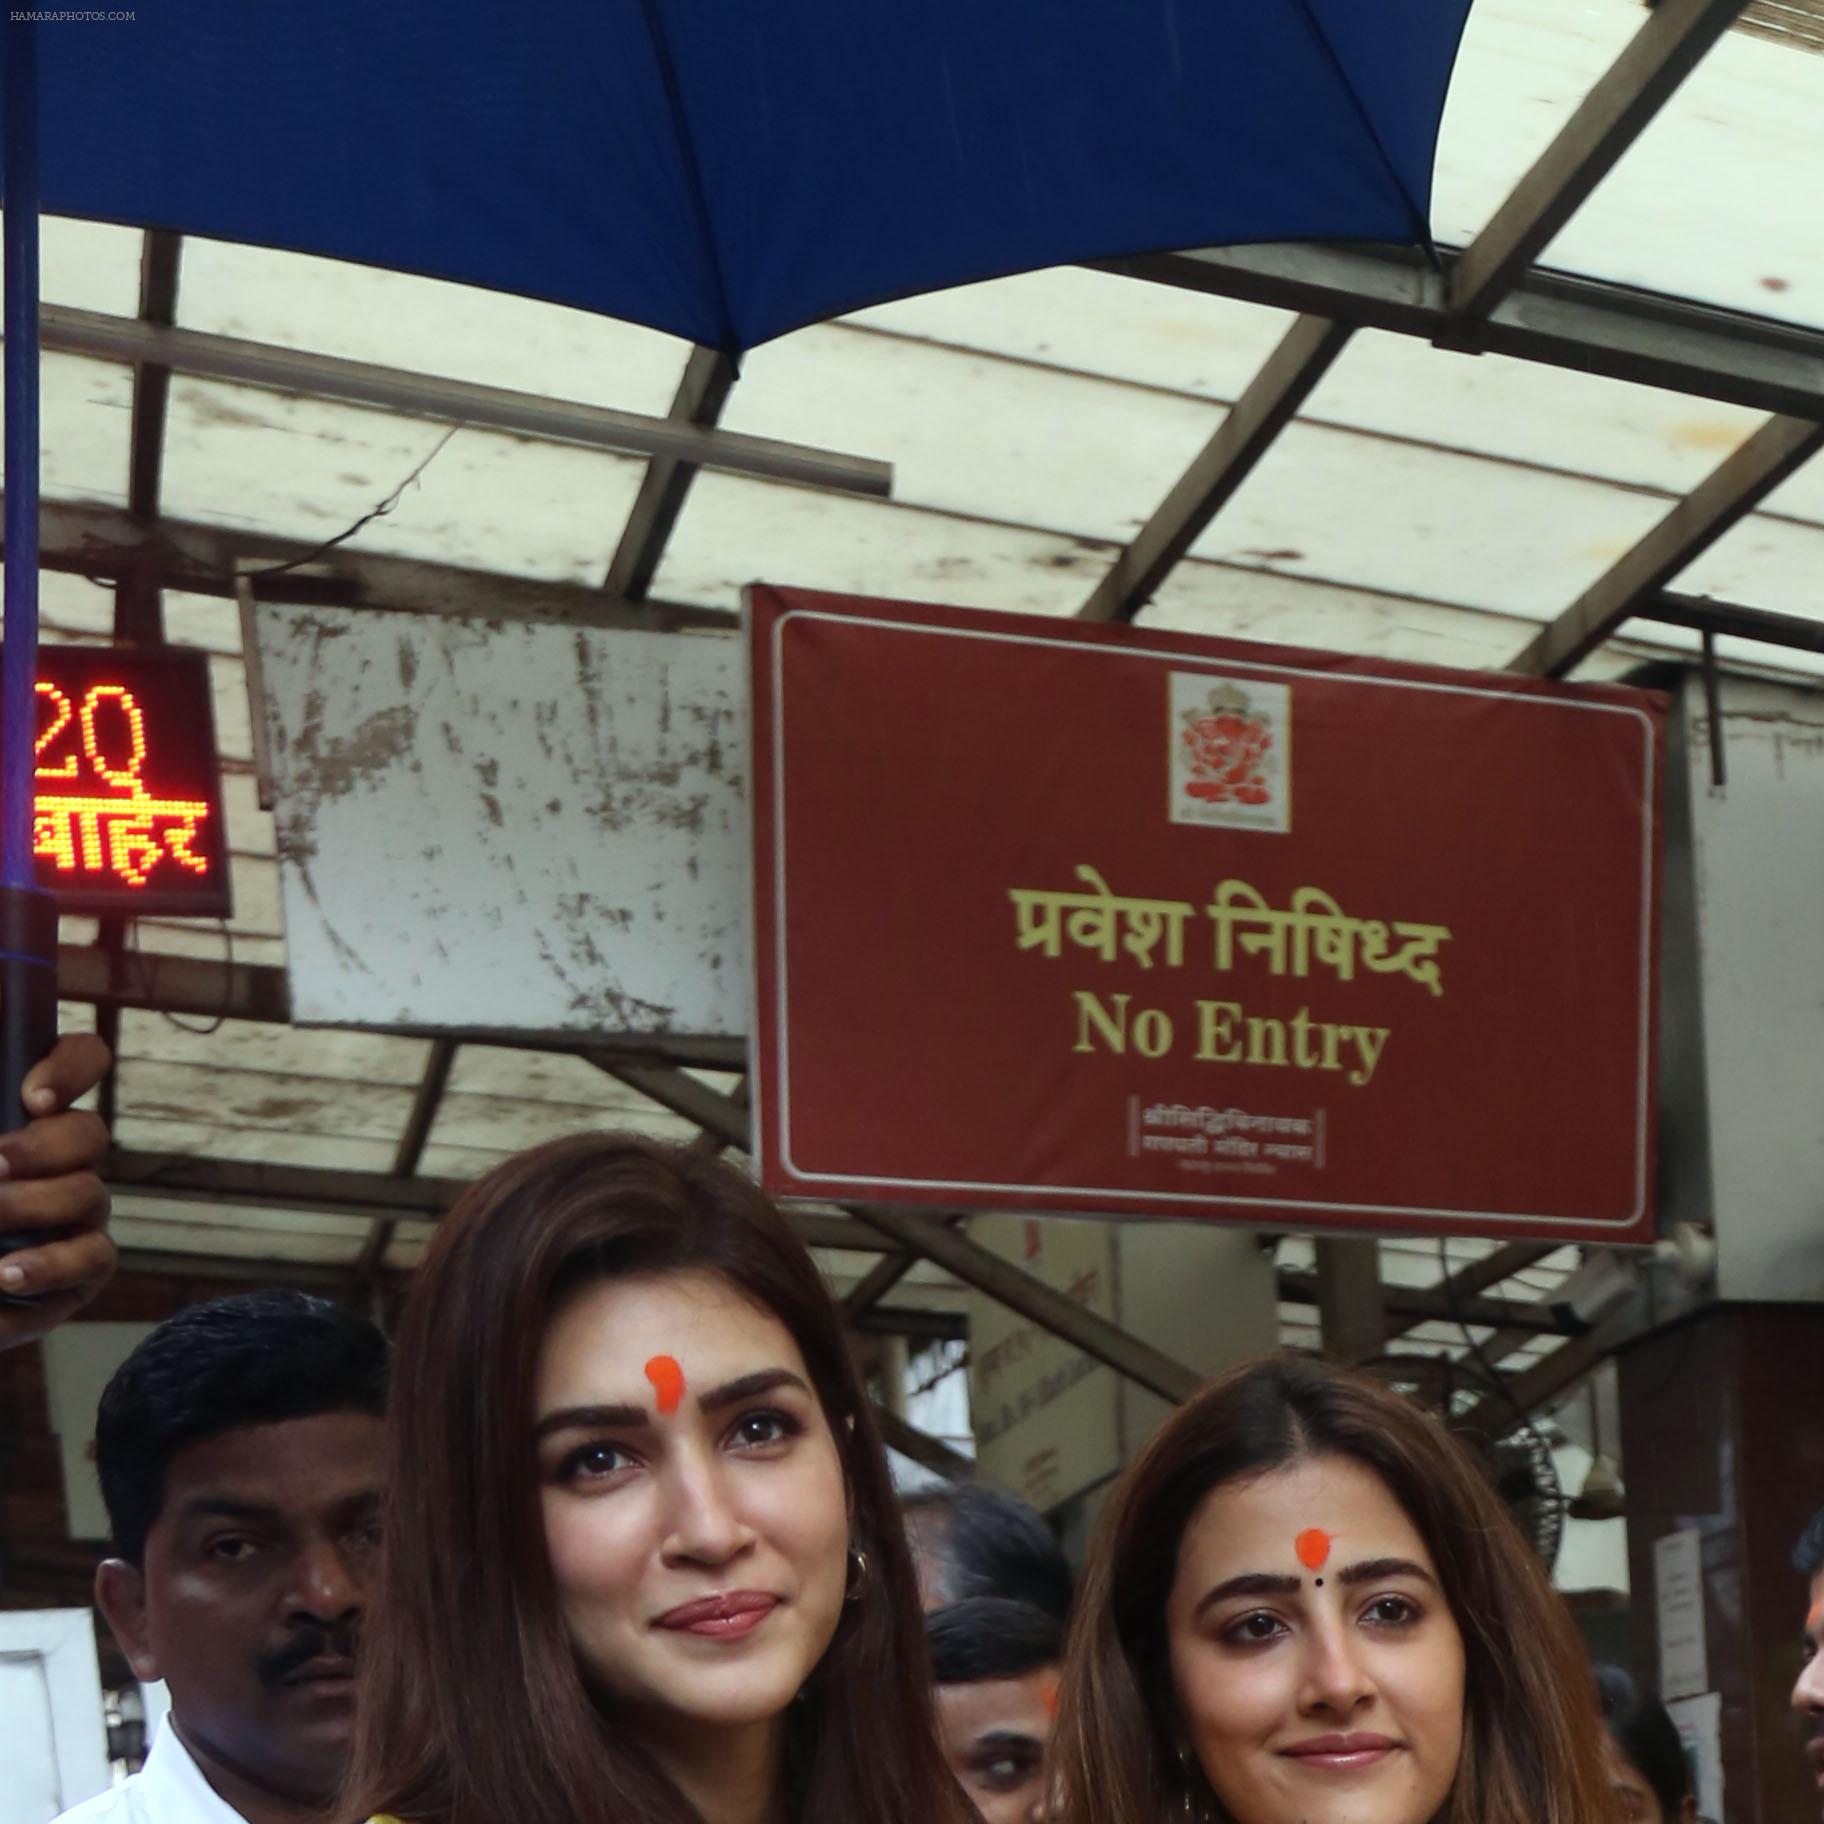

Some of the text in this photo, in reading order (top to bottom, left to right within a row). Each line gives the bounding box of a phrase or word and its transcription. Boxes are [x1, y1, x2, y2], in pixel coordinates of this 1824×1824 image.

[1009, 864, 1194, 968] प्रवेश
[1074, 992, 1391, 1086] No Entry
